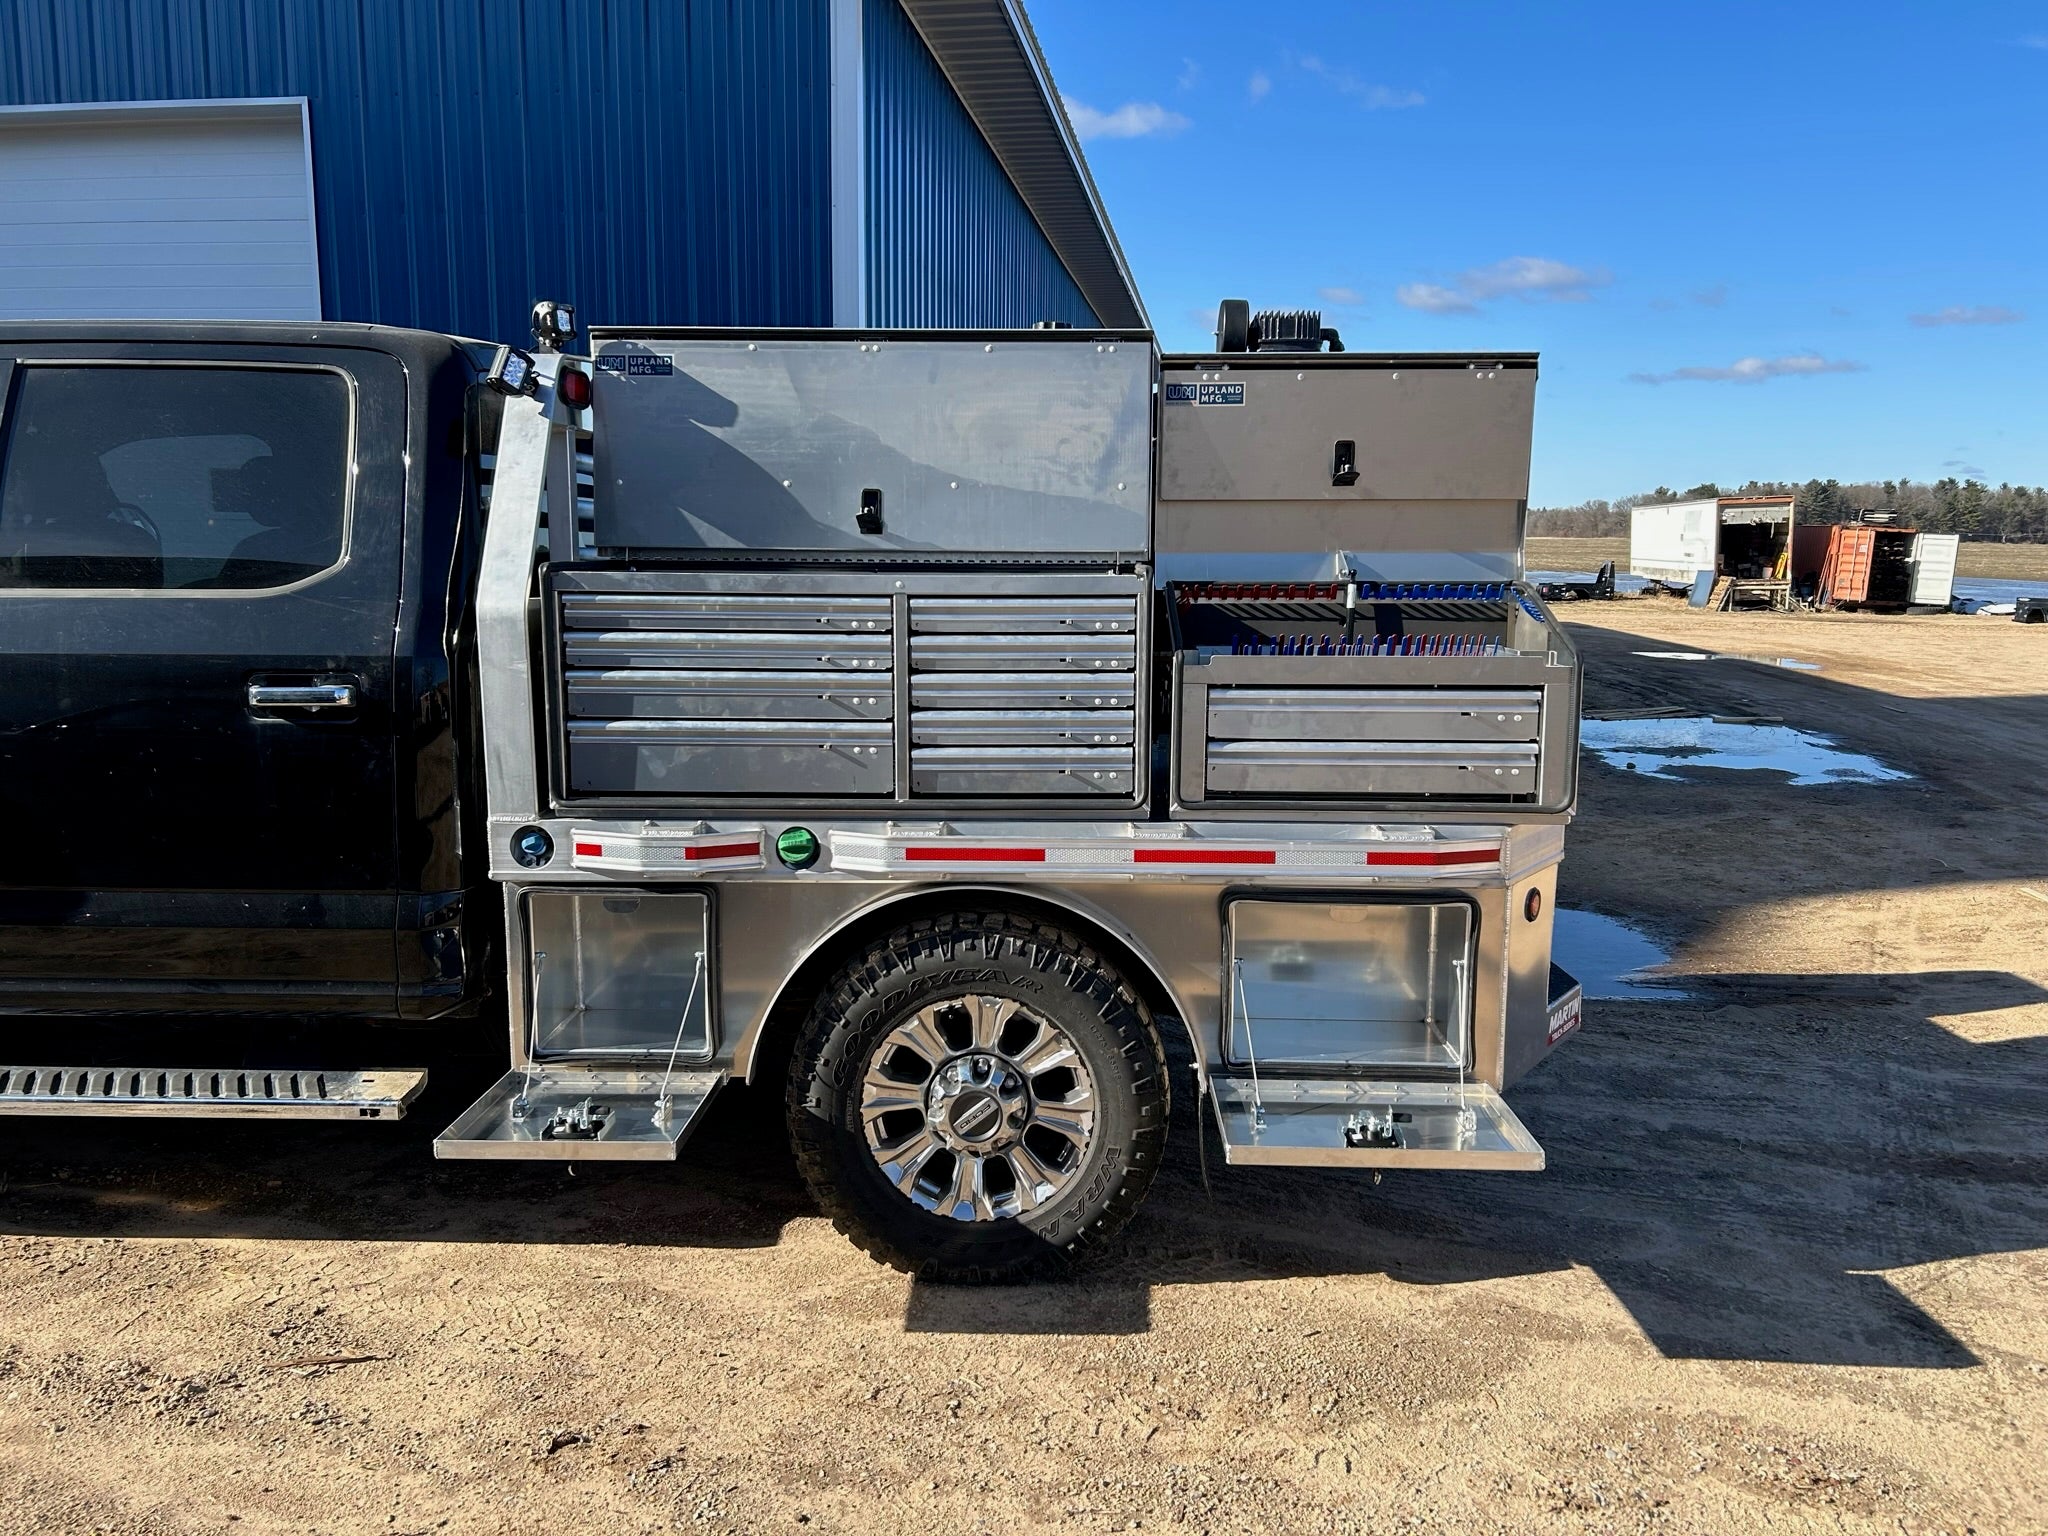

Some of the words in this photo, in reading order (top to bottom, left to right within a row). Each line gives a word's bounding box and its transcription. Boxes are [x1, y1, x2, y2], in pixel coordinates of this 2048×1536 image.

[630, 357, 671, 365] UPLAND
[630, 366, 655, 374] MFG.
[1201, 385, 1242, 394] UPLAND
[1201, 394, 1226, 403] MFG.
[1548, 995, 1580, 1034] MARTIN
[832, 967, 1044, 1087] GOODYEAR
